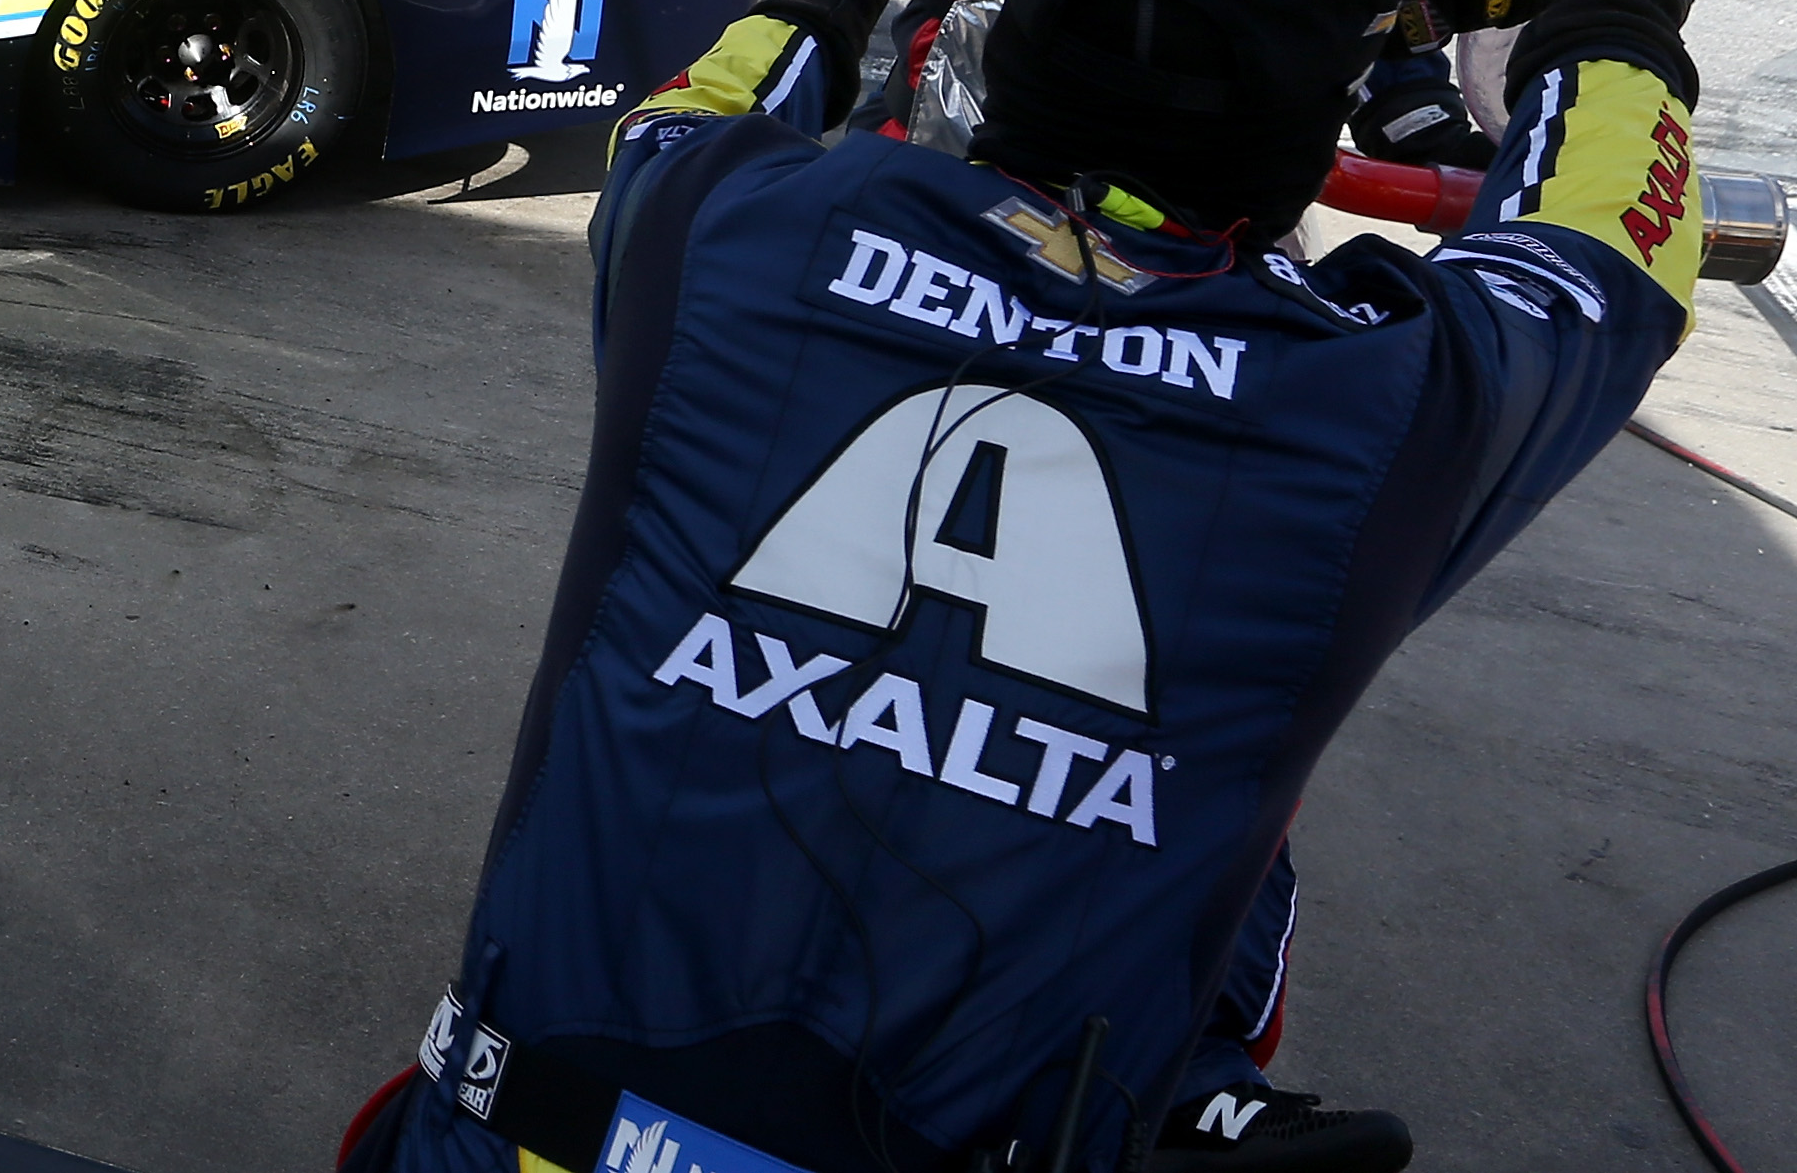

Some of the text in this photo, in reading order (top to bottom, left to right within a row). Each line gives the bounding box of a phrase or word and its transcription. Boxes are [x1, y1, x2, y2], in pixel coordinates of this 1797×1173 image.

[289, 85, 321, 127] LR6
[471, 84, 619, 114] Nationwide
[204, 139, 321, 210] EAGLE
[826, 228, 1248, 403] DENTON
[652, 612, 1164, 848] AXALTA
